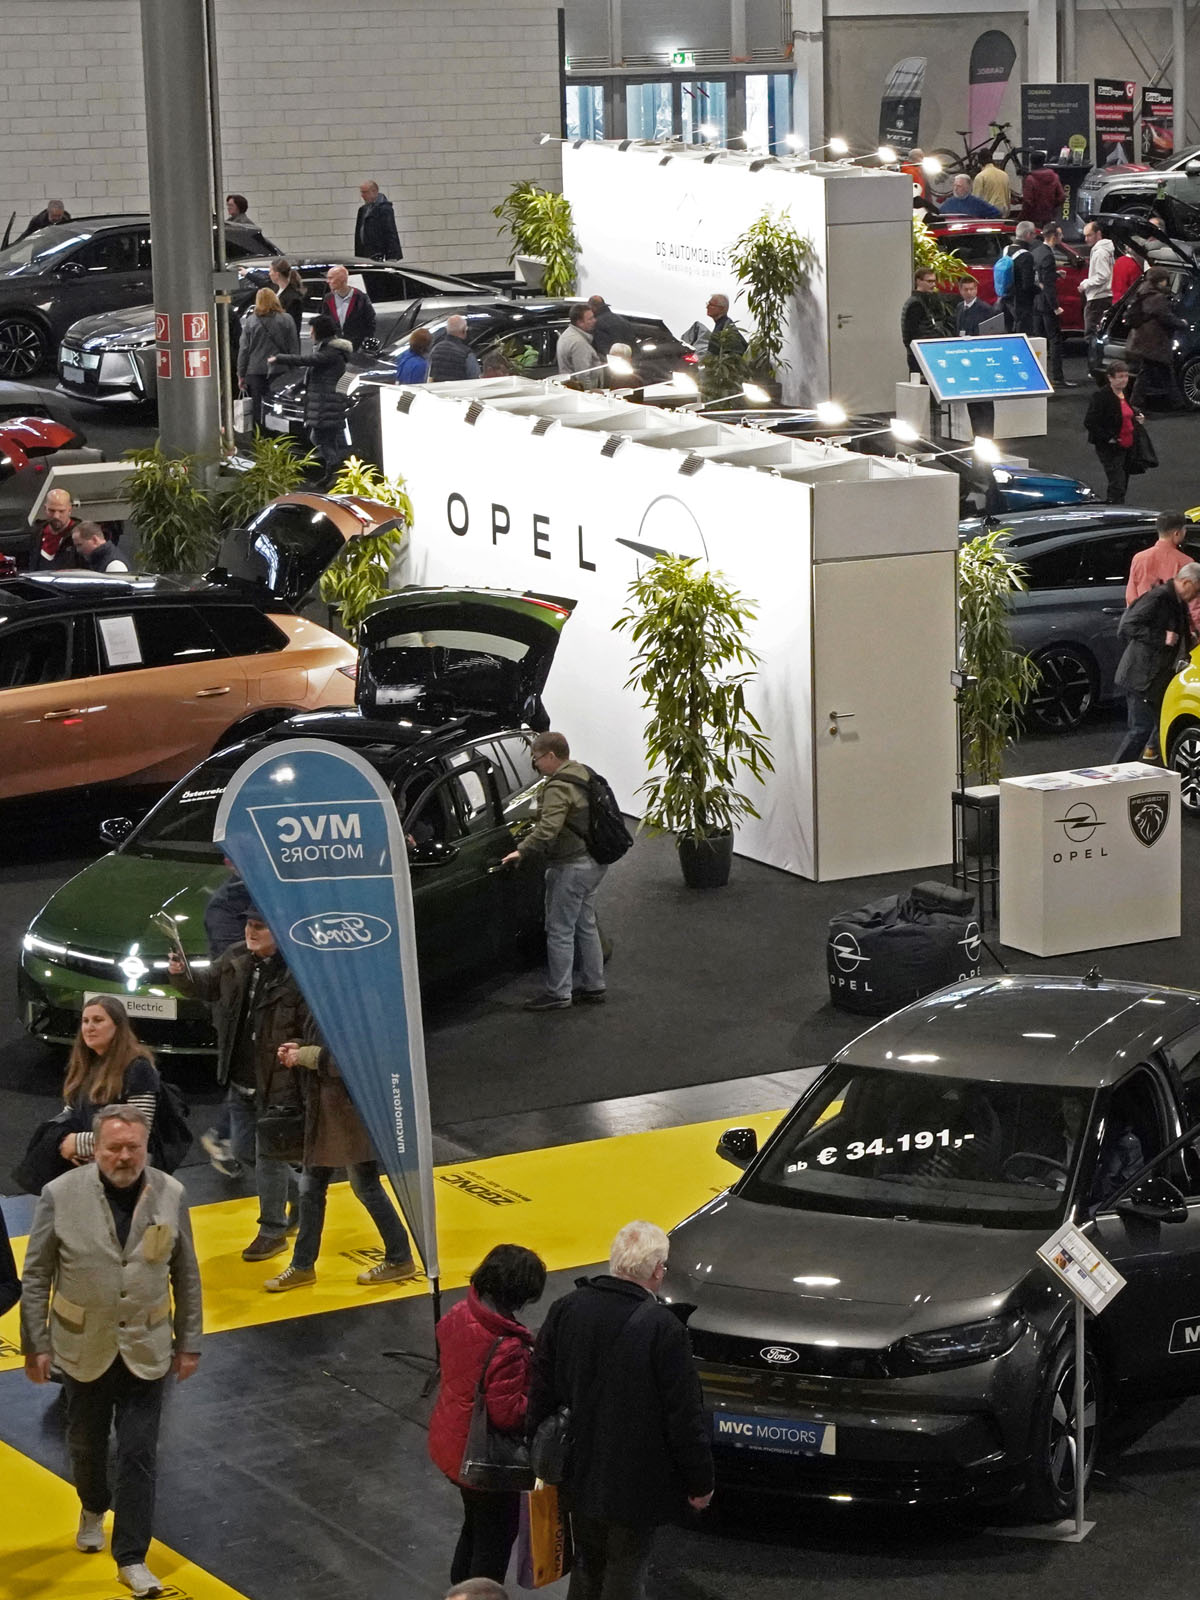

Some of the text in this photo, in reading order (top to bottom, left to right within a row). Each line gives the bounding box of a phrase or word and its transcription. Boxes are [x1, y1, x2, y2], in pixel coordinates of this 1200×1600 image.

[1062, 184, 1071, 221] JOBRAD
[656, 241, 728, 267] DS AUTOMOBILES
[447, 492, 597, 572] OPEL
[1131, 795, 1166, 805] PEUGEOT
[1053, 847, 1108, 863] OPEL
[830, 974, 873, 992] OPEL
[127, 1001, 164, 1012] Electric
[787, 1128, 975, 1173] ab € 34.191,-
[439, 1174, 517, 1207] ZGONC
[766, 1347, 793, 1361] Ford
[719, 1420, 816, 1444] MVC MOTORS
